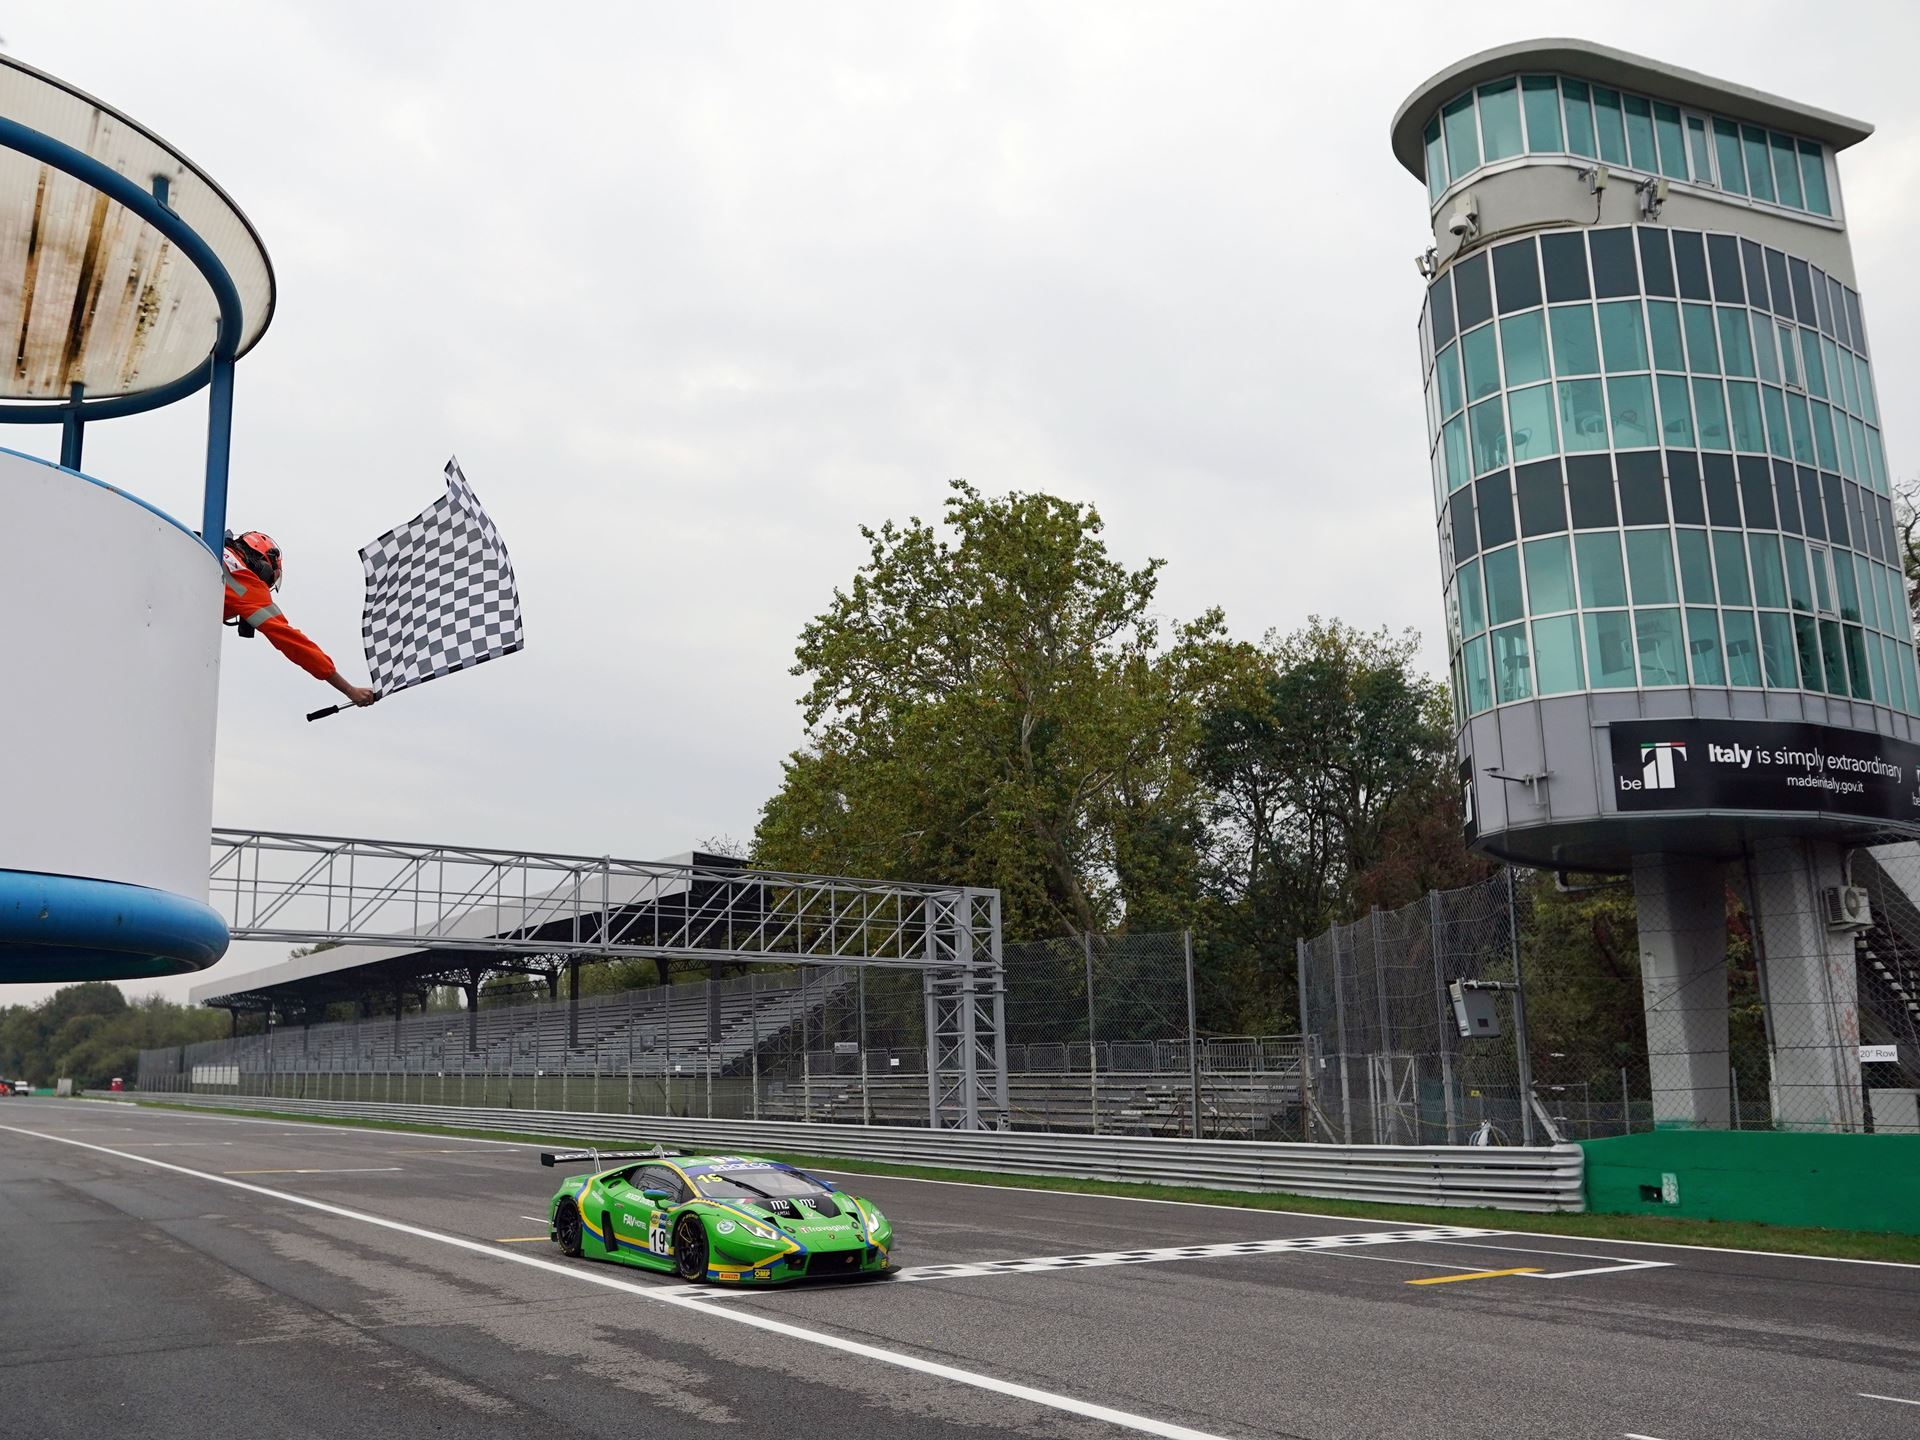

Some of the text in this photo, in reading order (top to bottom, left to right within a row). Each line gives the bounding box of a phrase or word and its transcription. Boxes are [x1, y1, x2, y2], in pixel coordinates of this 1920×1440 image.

[1708, 743, 1752, 768] Italy
[1756, 745, 1771, 764] is
[1775, 746, 1825, 772] simply
[1827, 756, 1902, 784] extraordinary
[1620, 775, 1642, 790] be
[1787, 774, 1864, 794] madeinitaly.gov.it
[1875, 1049, 1896, 1058] Row
[651, 1229, 666, 1253] 19
